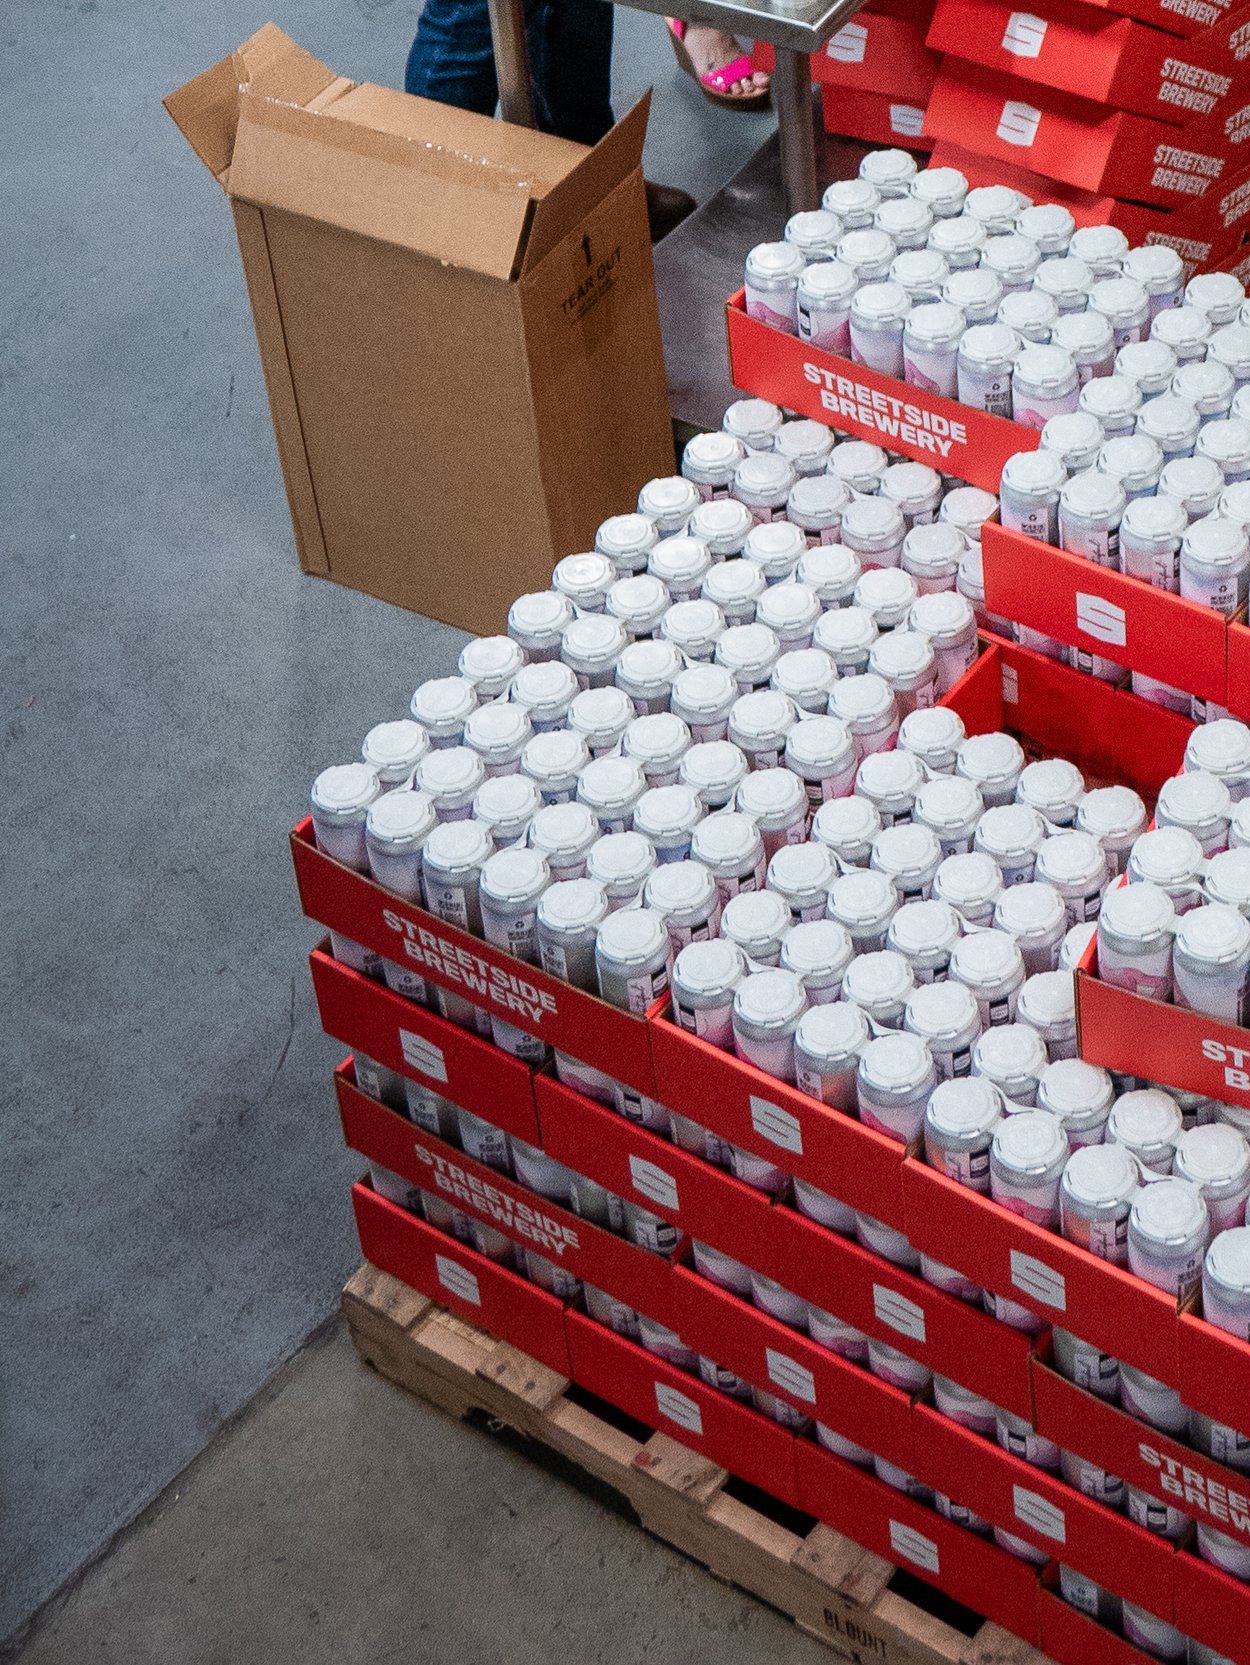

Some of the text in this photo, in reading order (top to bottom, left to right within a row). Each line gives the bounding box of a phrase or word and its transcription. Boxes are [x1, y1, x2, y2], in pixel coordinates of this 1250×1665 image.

[1158, 78, 1217, 114] BREWERY
[1160, 57, 1232, 95] STREETSIDE
[1151, 167, 1211, 197] BREWERY
[1153, 144, 1225, 178] STREETSIDE
[562, 276, 590, 312] TEAR
[596, 246, 621, 278] OUT
[804, 362, 967, 445] STREETSIDE
[821, 388, 952, 458] BREWERY
[382, 909, 556, 1014] STREETSIDE
[404, 937, 545, 1025] BREWERY
[414, 1143, 579, 1249] STREETSIDE
[433, 1169, 568, 1257] BREWERY
[823, 1607, 887, 1658] BLOUNT
